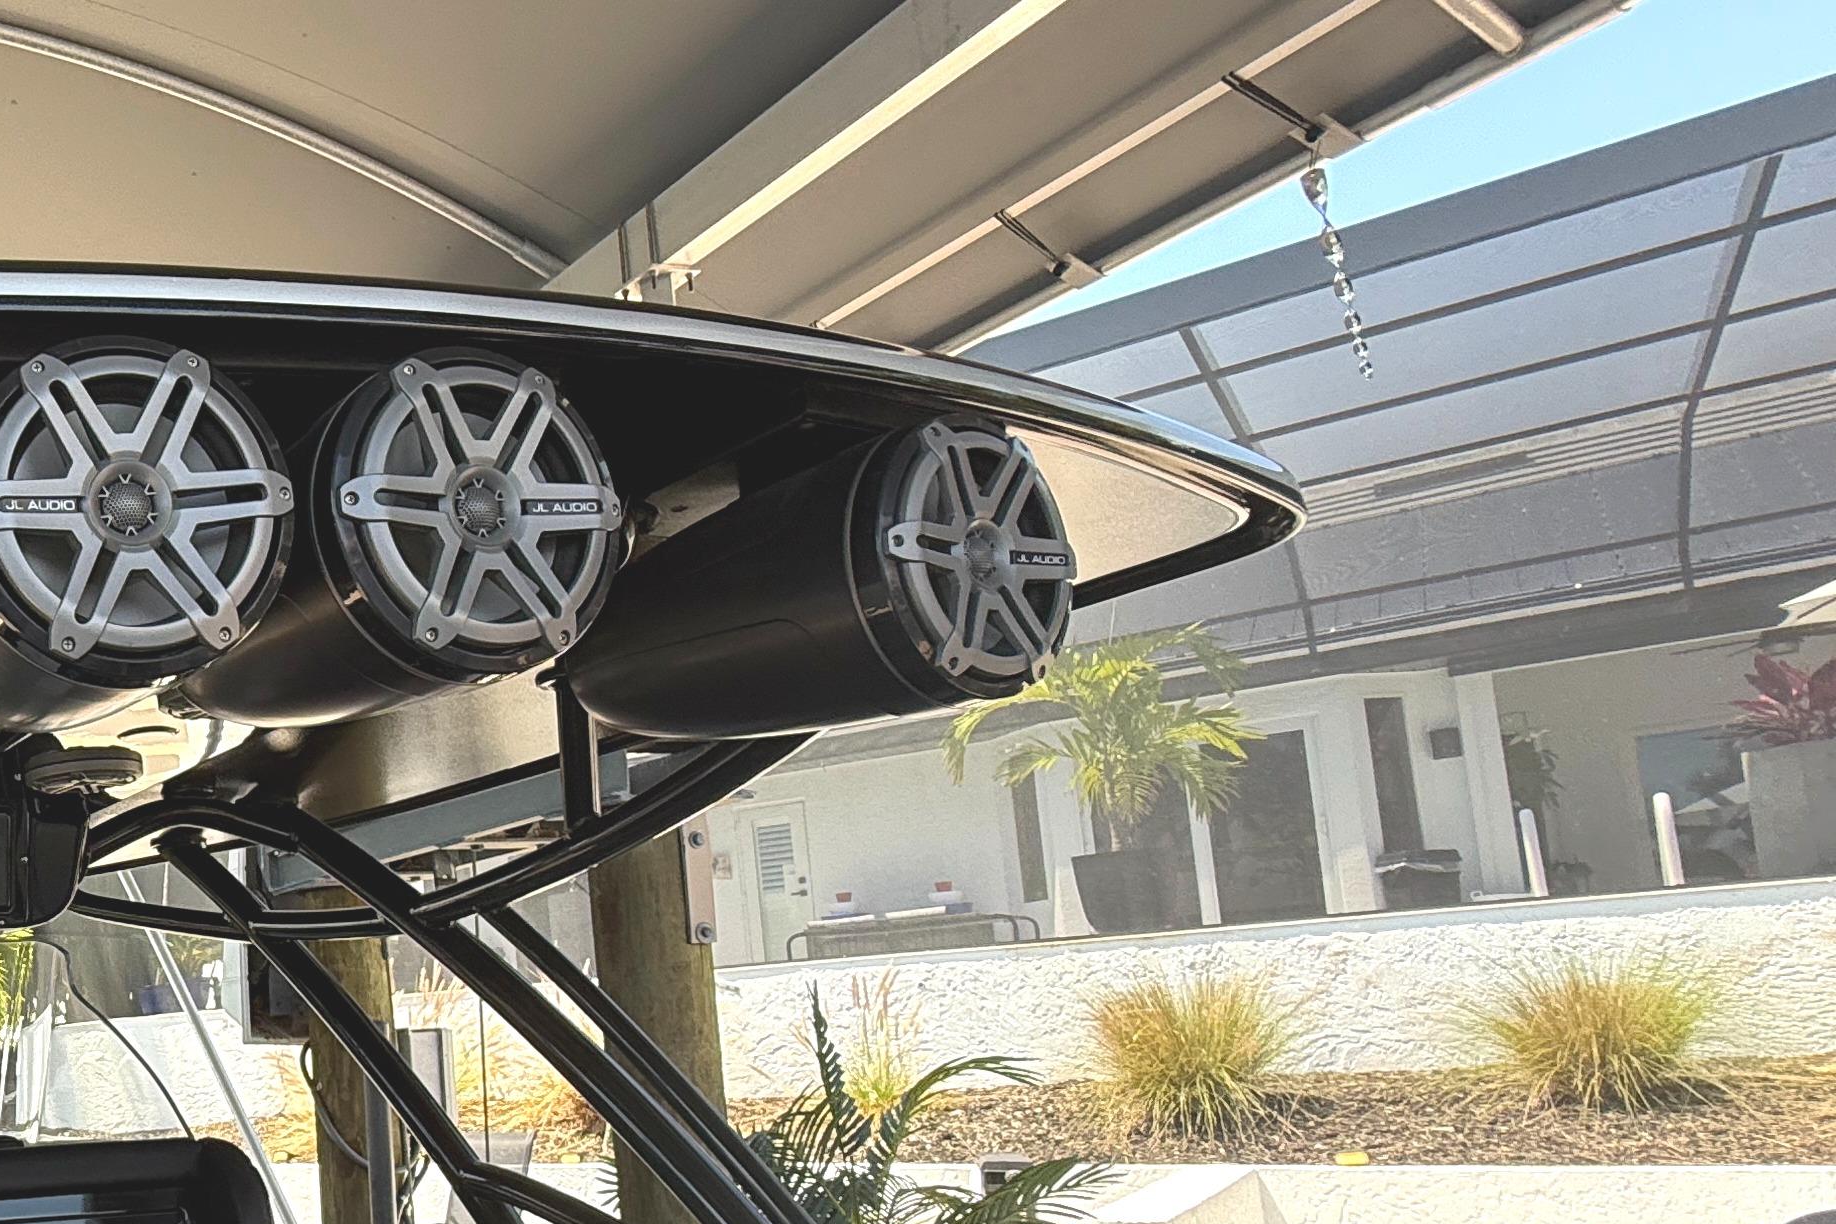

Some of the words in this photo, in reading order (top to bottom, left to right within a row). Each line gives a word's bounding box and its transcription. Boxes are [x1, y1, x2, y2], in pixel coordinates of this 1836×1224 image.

[6, 499, 24, 510] JL
[27, 499, 75, 511] AUDIO
[532, 502, 549, 512] JL
[552, 502, 597, 512] AUDIO
